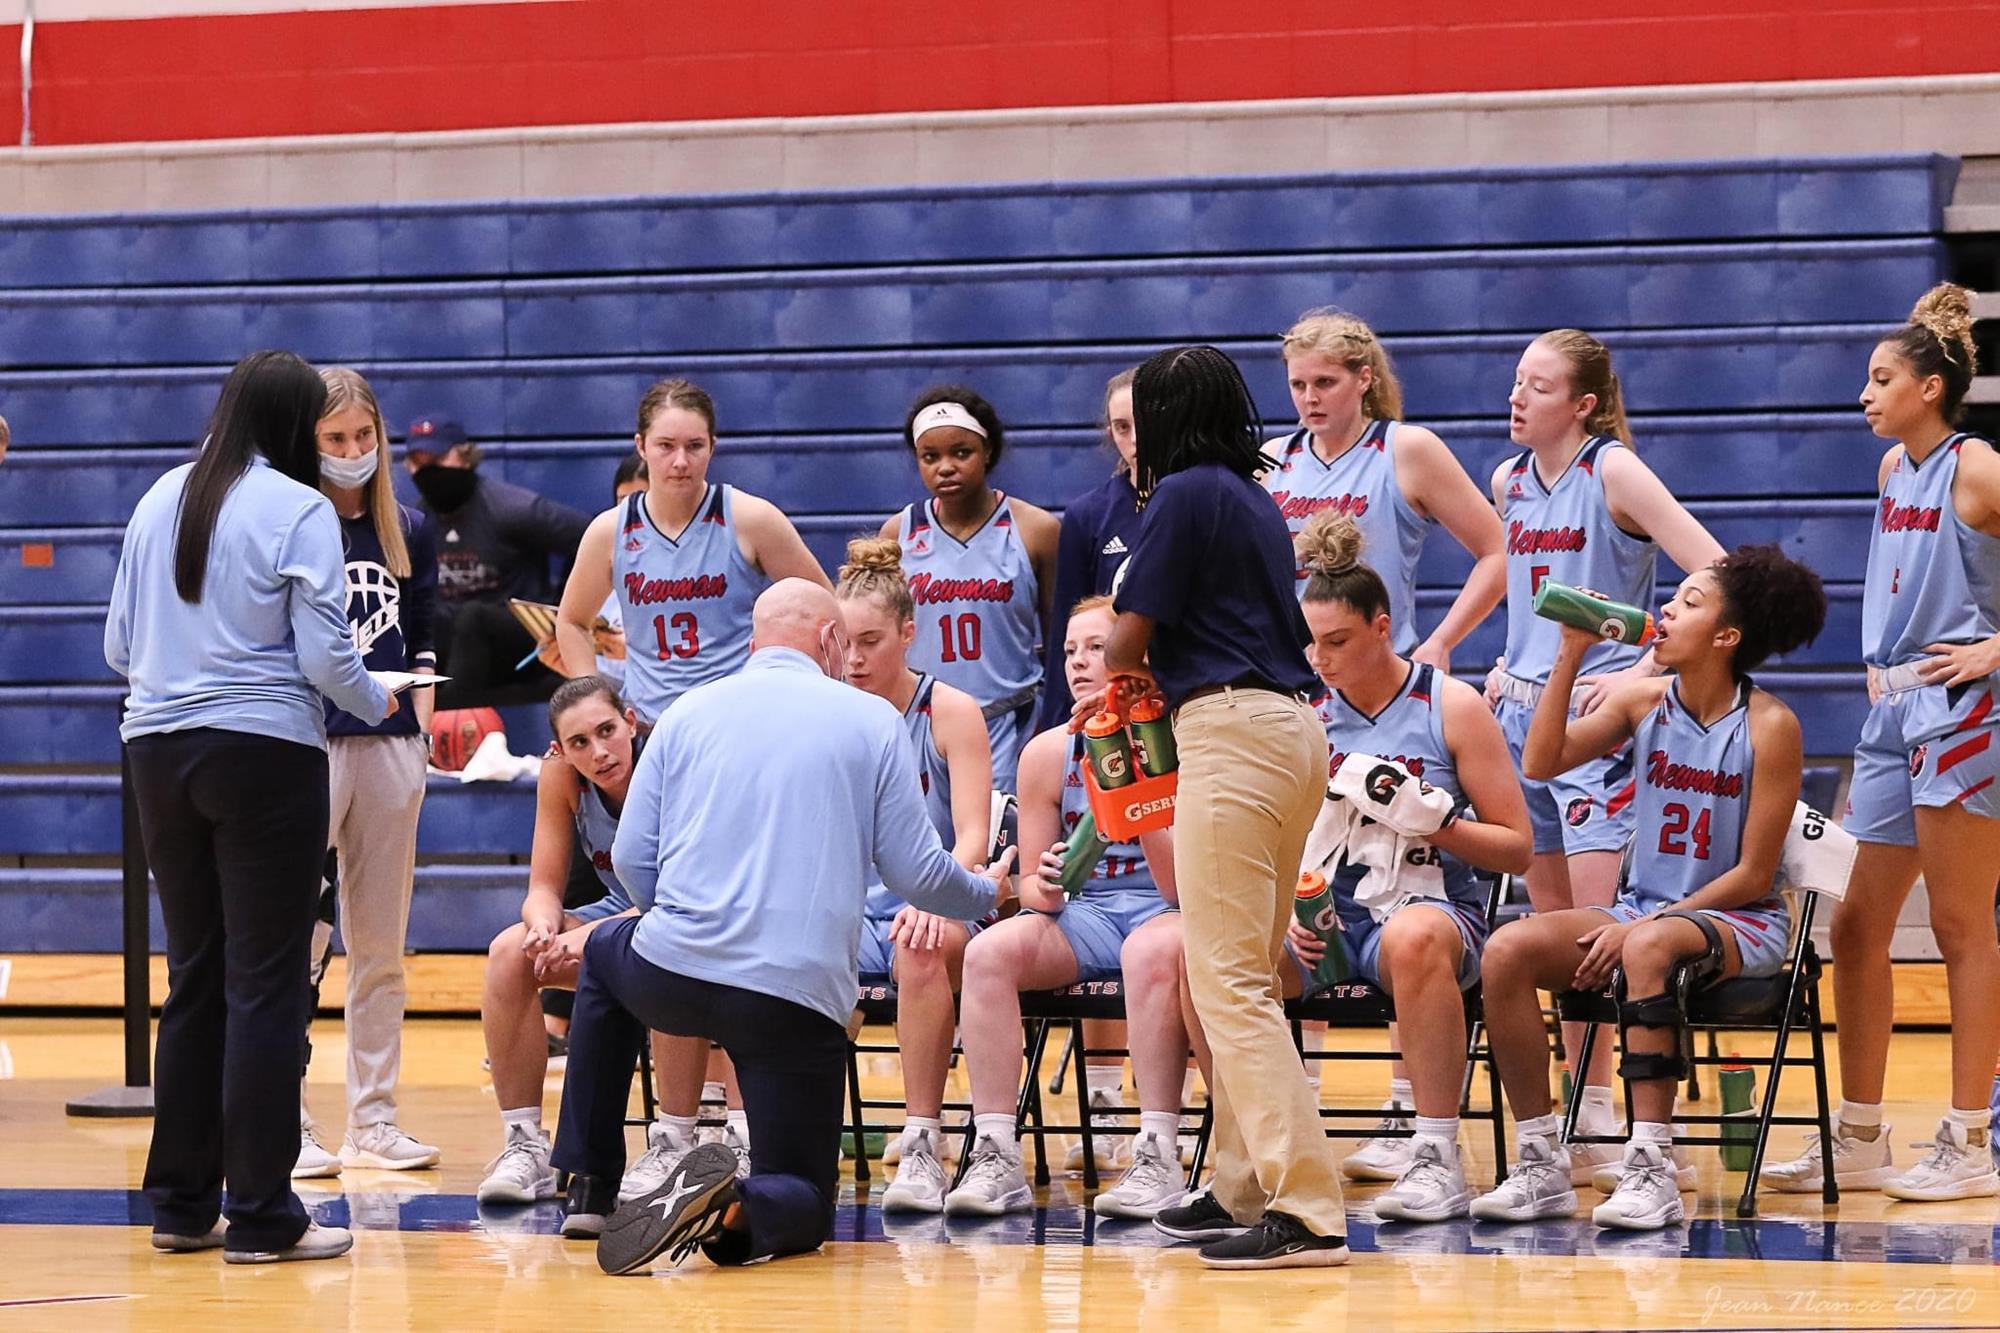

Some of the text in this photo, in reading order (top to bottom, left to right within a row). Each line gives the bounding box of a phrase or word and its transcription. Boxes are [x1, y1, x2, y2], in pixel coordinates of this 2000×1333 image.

[1507, 520, 1587, 556] Newman
[624, 571, 728, 606] Newman
[908, 571, 1014, 606] Newman
[653, 612, 699, 661] 13
[938, 612, 981, 663] 10
[1365, 764, 1408, 806] G
[1647, 750, 1743, 799] Newman
[1658, 802, 1712, 860] 24
